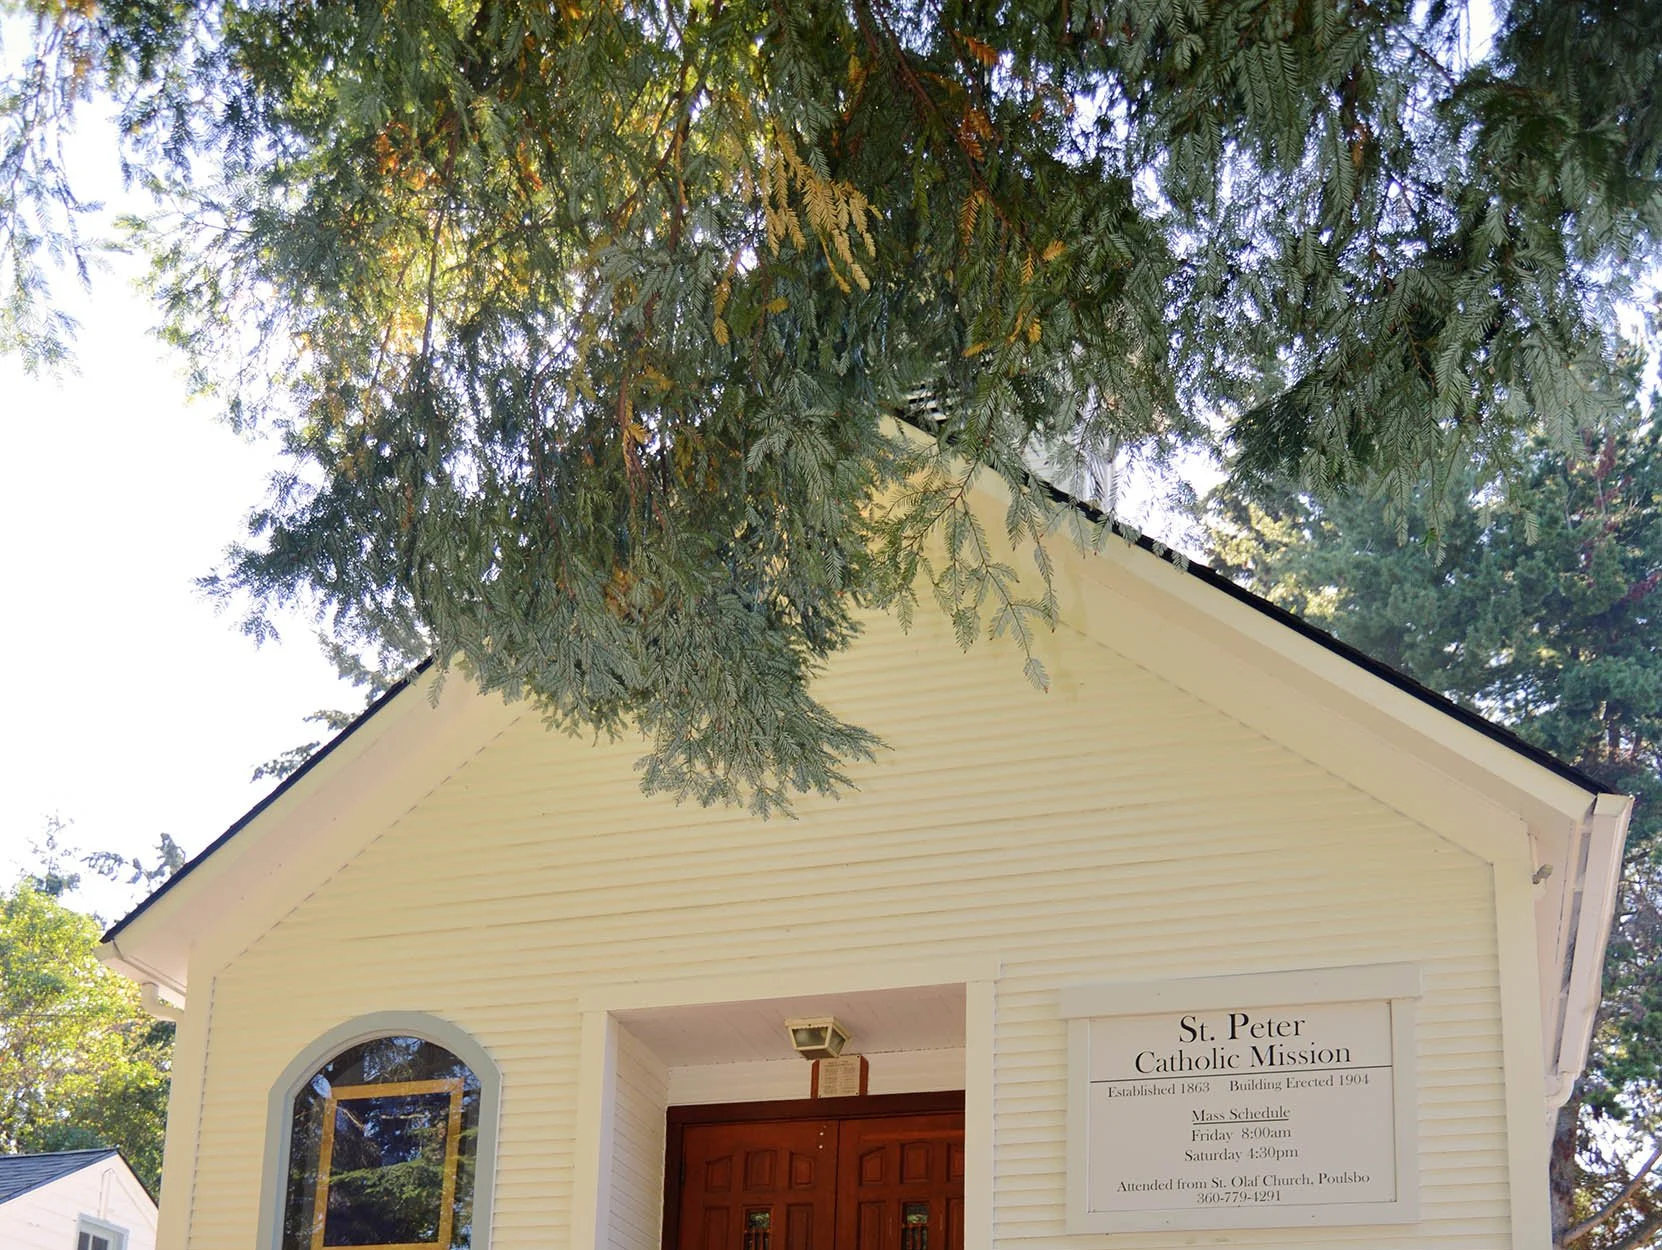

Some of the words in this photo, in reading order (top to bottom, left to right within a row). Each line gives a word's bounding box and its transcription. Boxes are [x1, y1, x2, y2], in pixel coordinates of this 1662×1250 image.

[1179, 1015, 1215, 1043] St.
[1228, 1012, 1306, 1040] Peter
[1135, 1046, 1239, 1074] Catholic
[1250, 1042, 1351, 1067] Mission
[1108, 1082, 1175, 1098] Established
[1180, 1082, 1210, 1094] 1863
[1229, 1078, 1282, 1092] Building
[1286, 1075, 1334, 1088] Erected
[1339, 1074, 1369, 1086] 1904
[1192, 1109, 1225, 1122] Mass
[1229, 1106, 1291, 1121] Schedule
[1191, 1128, 1233, 1142] Friday
[1241, 1127, 1291, 1139] 8:00am
[1184, 1148, 1242, 1162] Saturday
[1248, 1147, 1299, 1160] 4:30pm
[1117, 1178, 1172, 1192] Attended
[1178, 1178, 1207, 1190] from
[1211, 1176, 1228, 1189] St.
[1231, 1175, 1259, 1188] Olaf
[1318, 1172, 1370, 1184] Poulsbo
